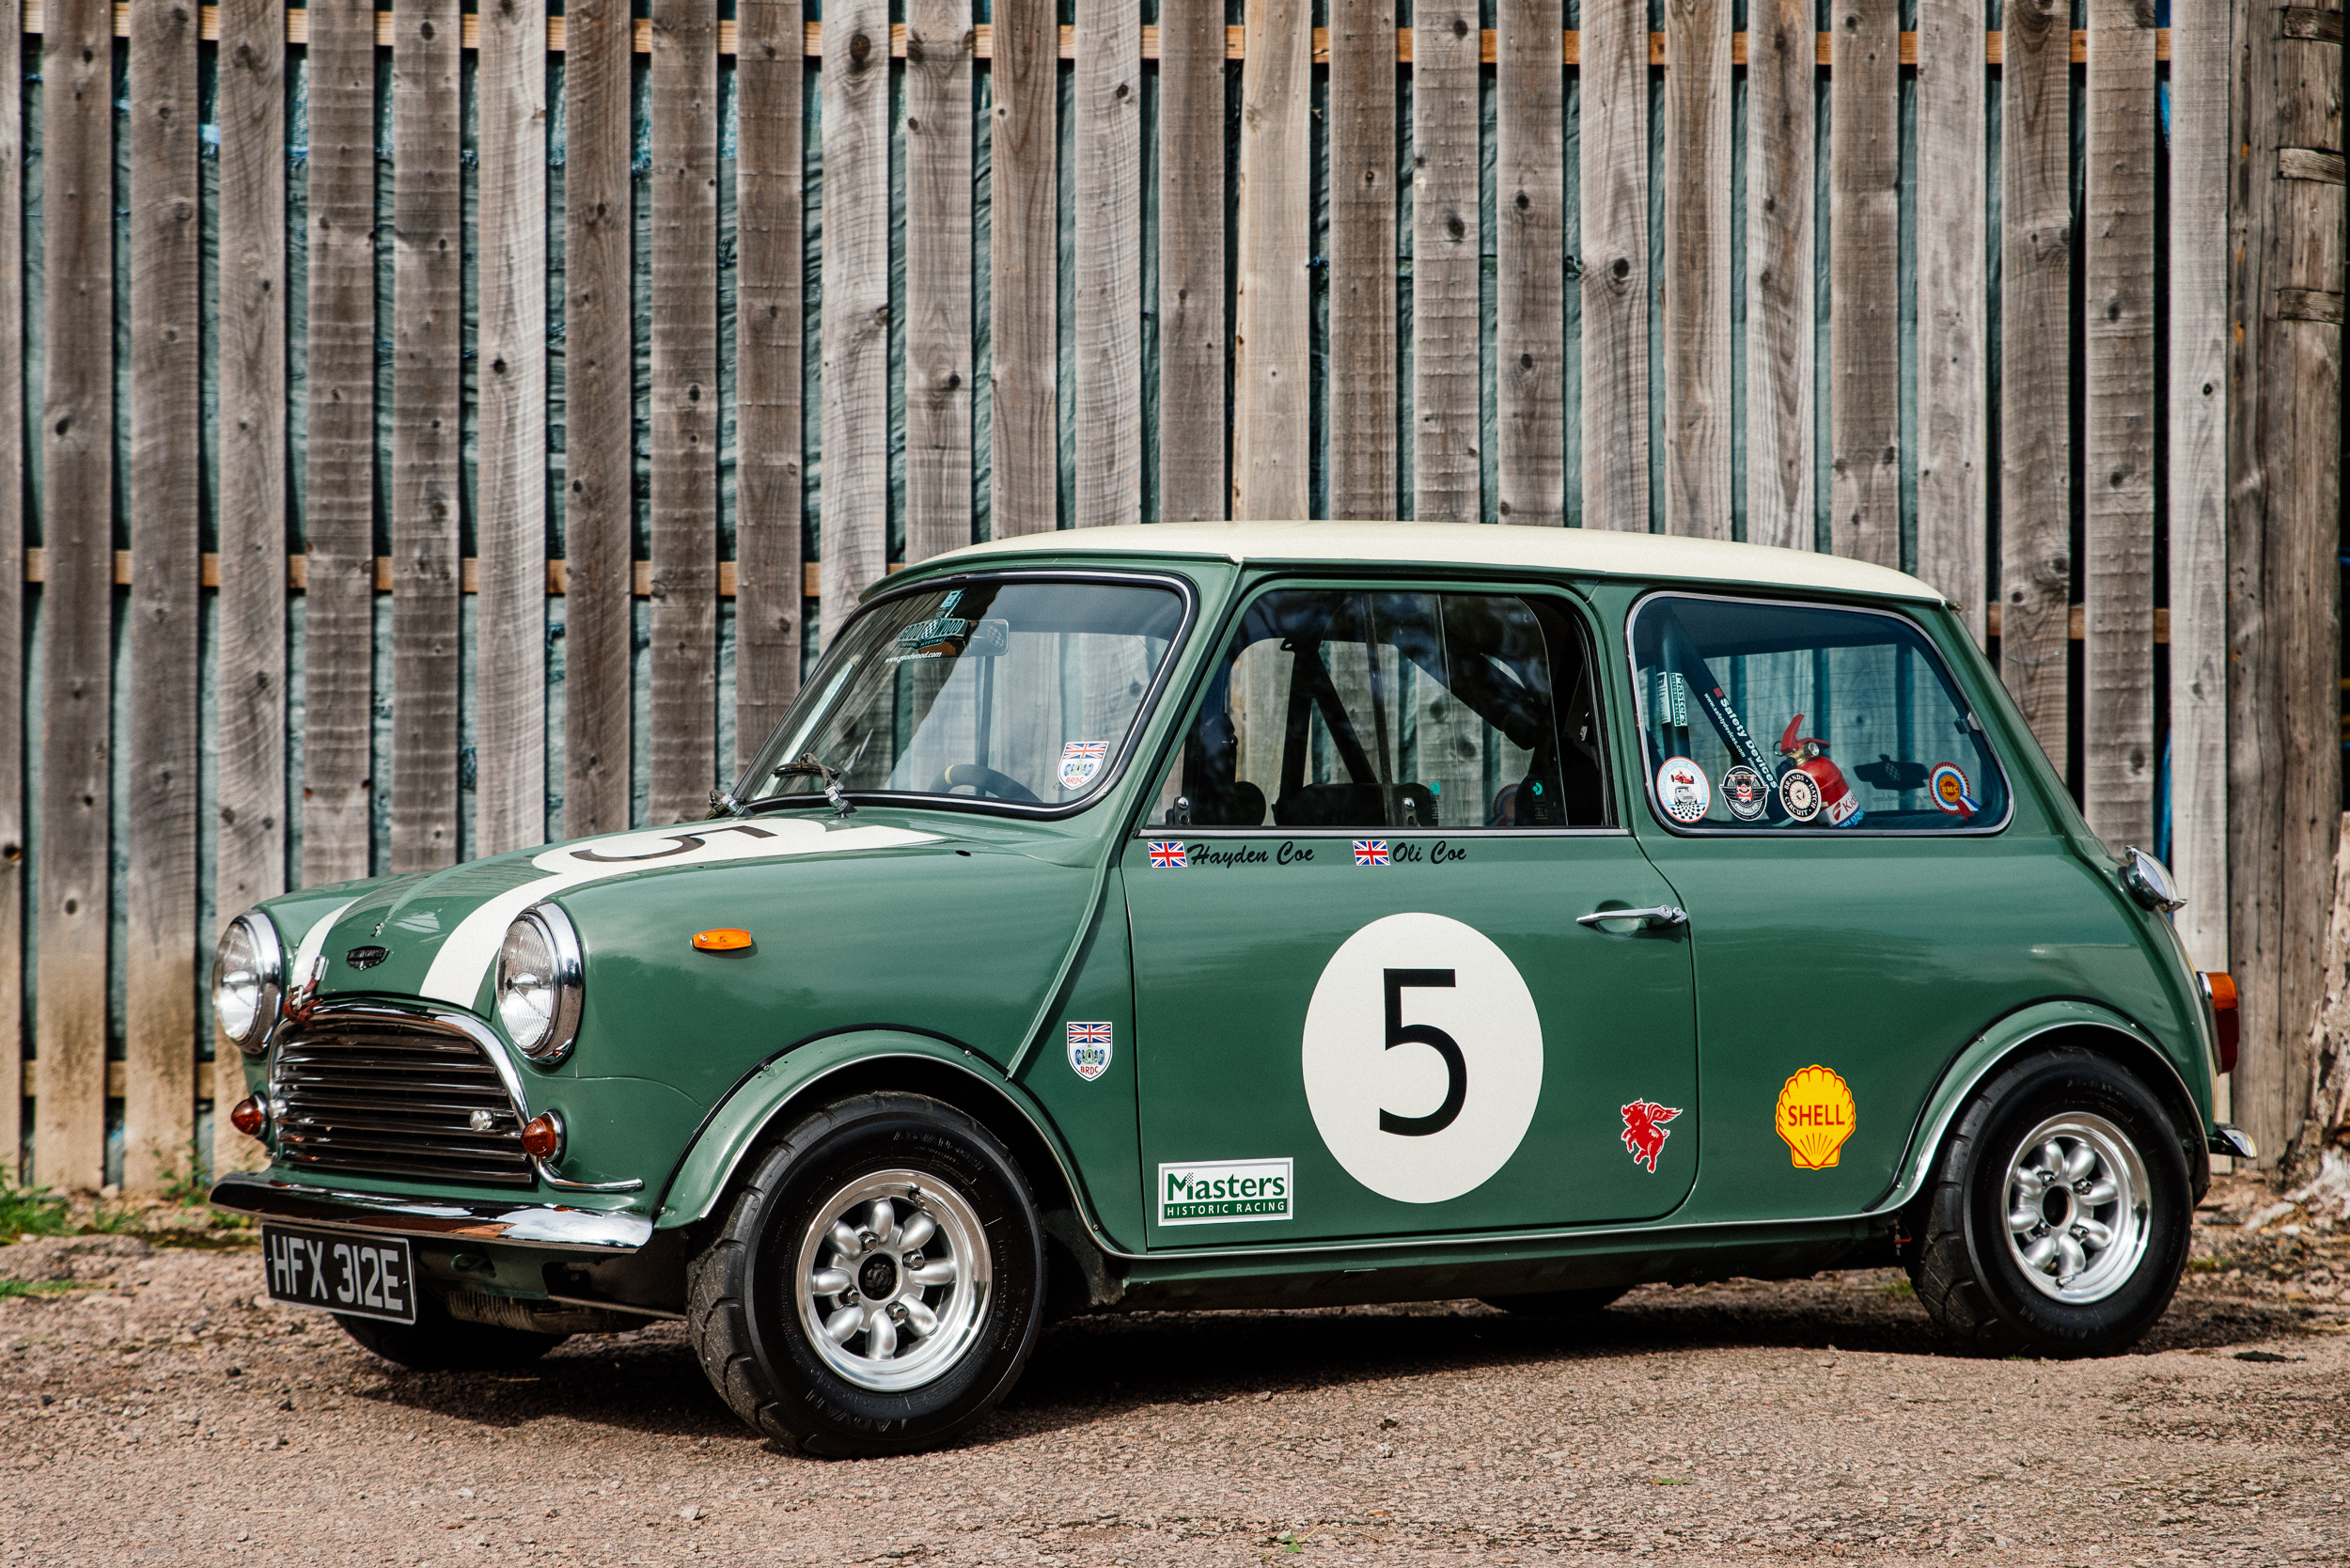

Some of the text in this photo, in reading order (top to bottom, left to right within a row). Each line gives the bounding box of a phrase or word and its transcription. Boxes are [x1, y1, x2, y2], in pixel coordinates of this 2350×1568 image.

[885, 651, 942, 664] www.goodwood.com
[1676, 674, 1687, 725] Masters
[1704, 693, 1746, 758] www.safetydevices.com
[1720, 698, 1747, 737] Safety
[1746, 740, 1778, 789] Devices
[1784, 774, 1818, 809] BRANDS HATCH
[1784, 796, 1808, 816] CIRCUIT
[1186, 840, 1314, 869] Hayden Coe
[1392, 840, 1466, 864] Oli Coe
[1379, 967, 1467, 1137] 5
[1080, 1065, 1099, 1075] BRDC
[1788, 1104, 1845, 1127] SHELL
[1167, 1172, 1285, 1201] Masters
[1167, 1200, 1285, 1216] HISTORIC RACING
[272, 1234, 403, 1311] HFX 312E
